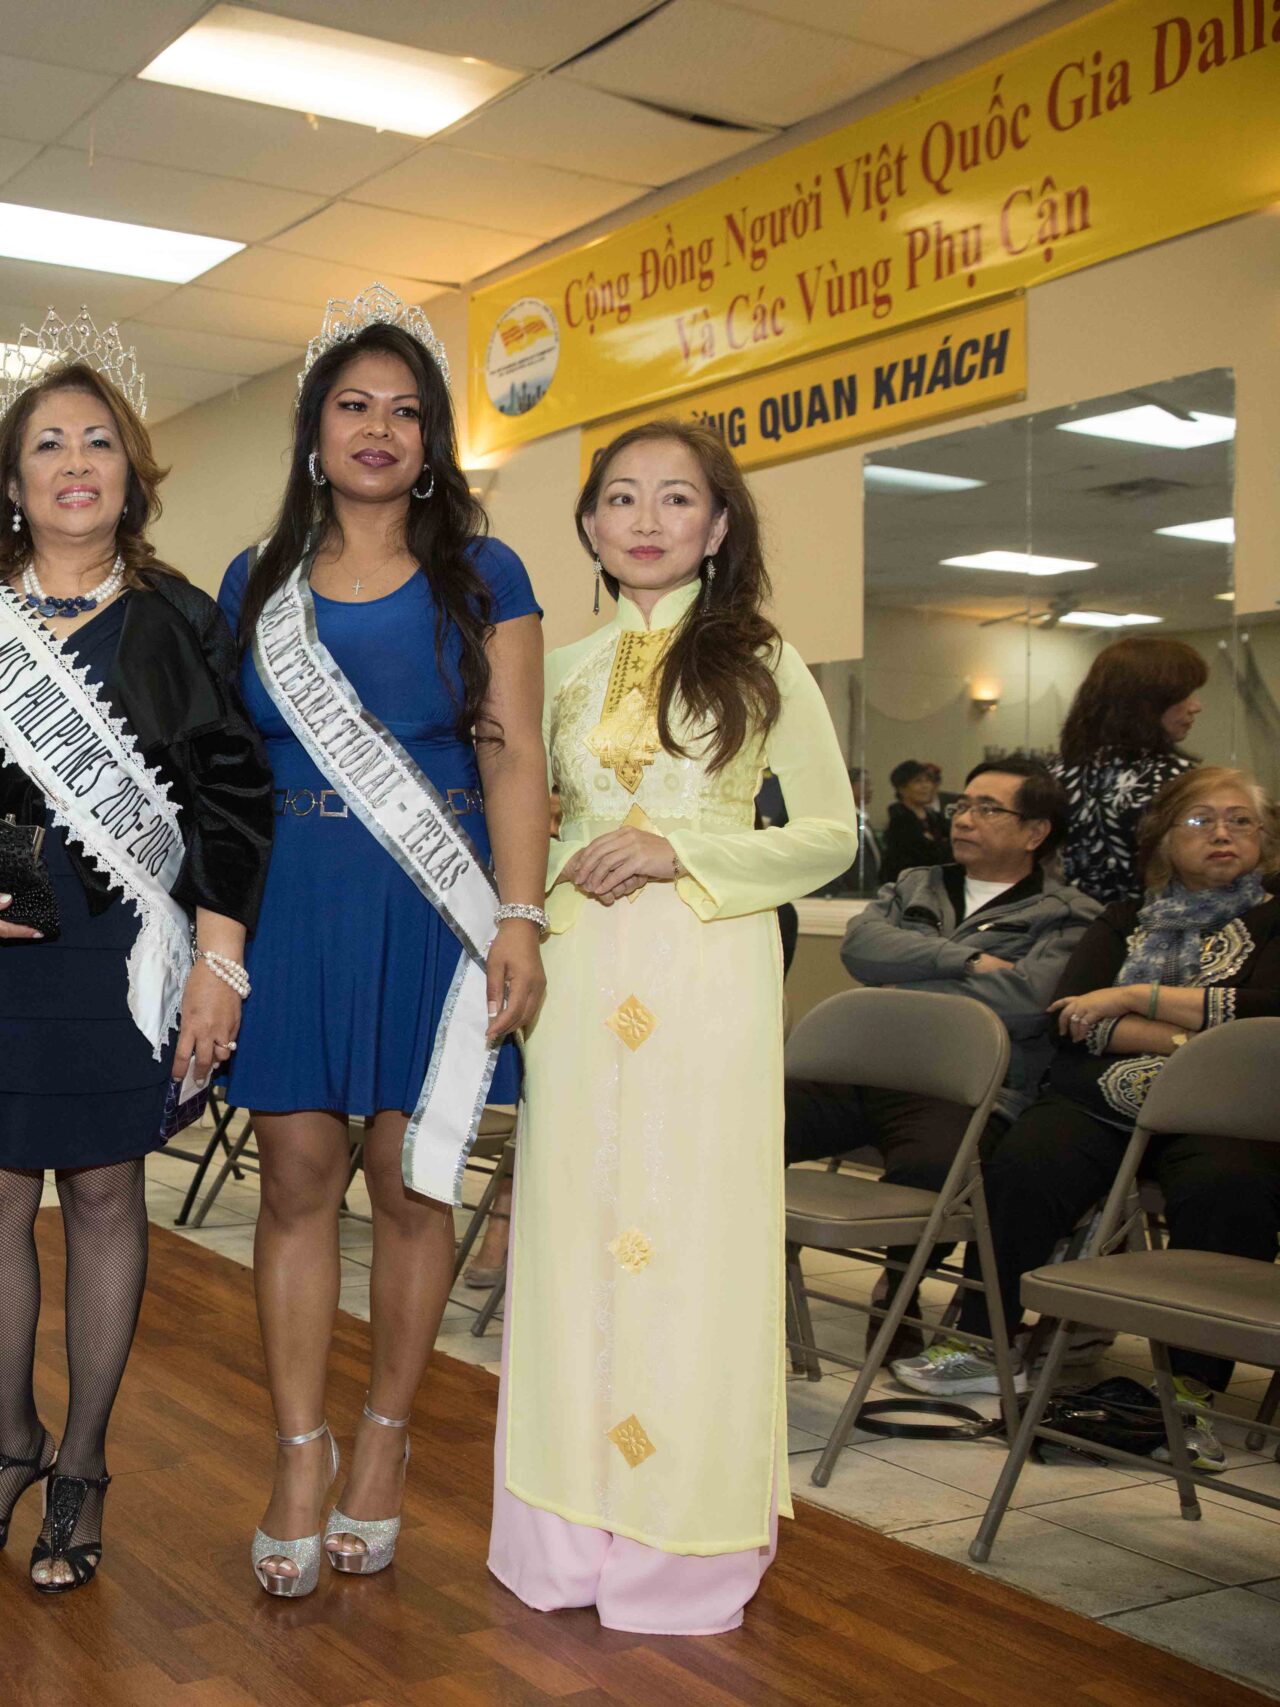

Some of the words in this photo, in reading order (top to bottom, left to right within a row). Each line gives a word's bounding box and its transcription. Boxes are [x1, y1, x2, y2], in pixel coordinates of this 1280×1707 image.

[564, 271, 631, 335] Cộng
[640, 222, 714, 300] Đồng
[723, 173, 823, 272] Người
[834, 141, 908, 223] Việt
[921, 73, 1031, 196] Quốc
[1047, 50, 1132, 132] Gia
[1149, 0, 1280, 95] Dall
[675, 308, 716, 363] Và
[726, 285, 786, 350] Các
[797, 258, 893, 324] Vùng
[906, 220, 982, 291] Phụ
[1000, 175, 1092, 264] Cận
[758, 374, 859, 442] QUAN
[872, 328, 1011, 410] KHÁCH
[3, 674, 118, 798] PHILIPPINES
[90, 776, 177, 877] 2015-2016
[265, 624, 408, 810] INTERNATIONAL
[398, 808, 469, 891] TEXAS
